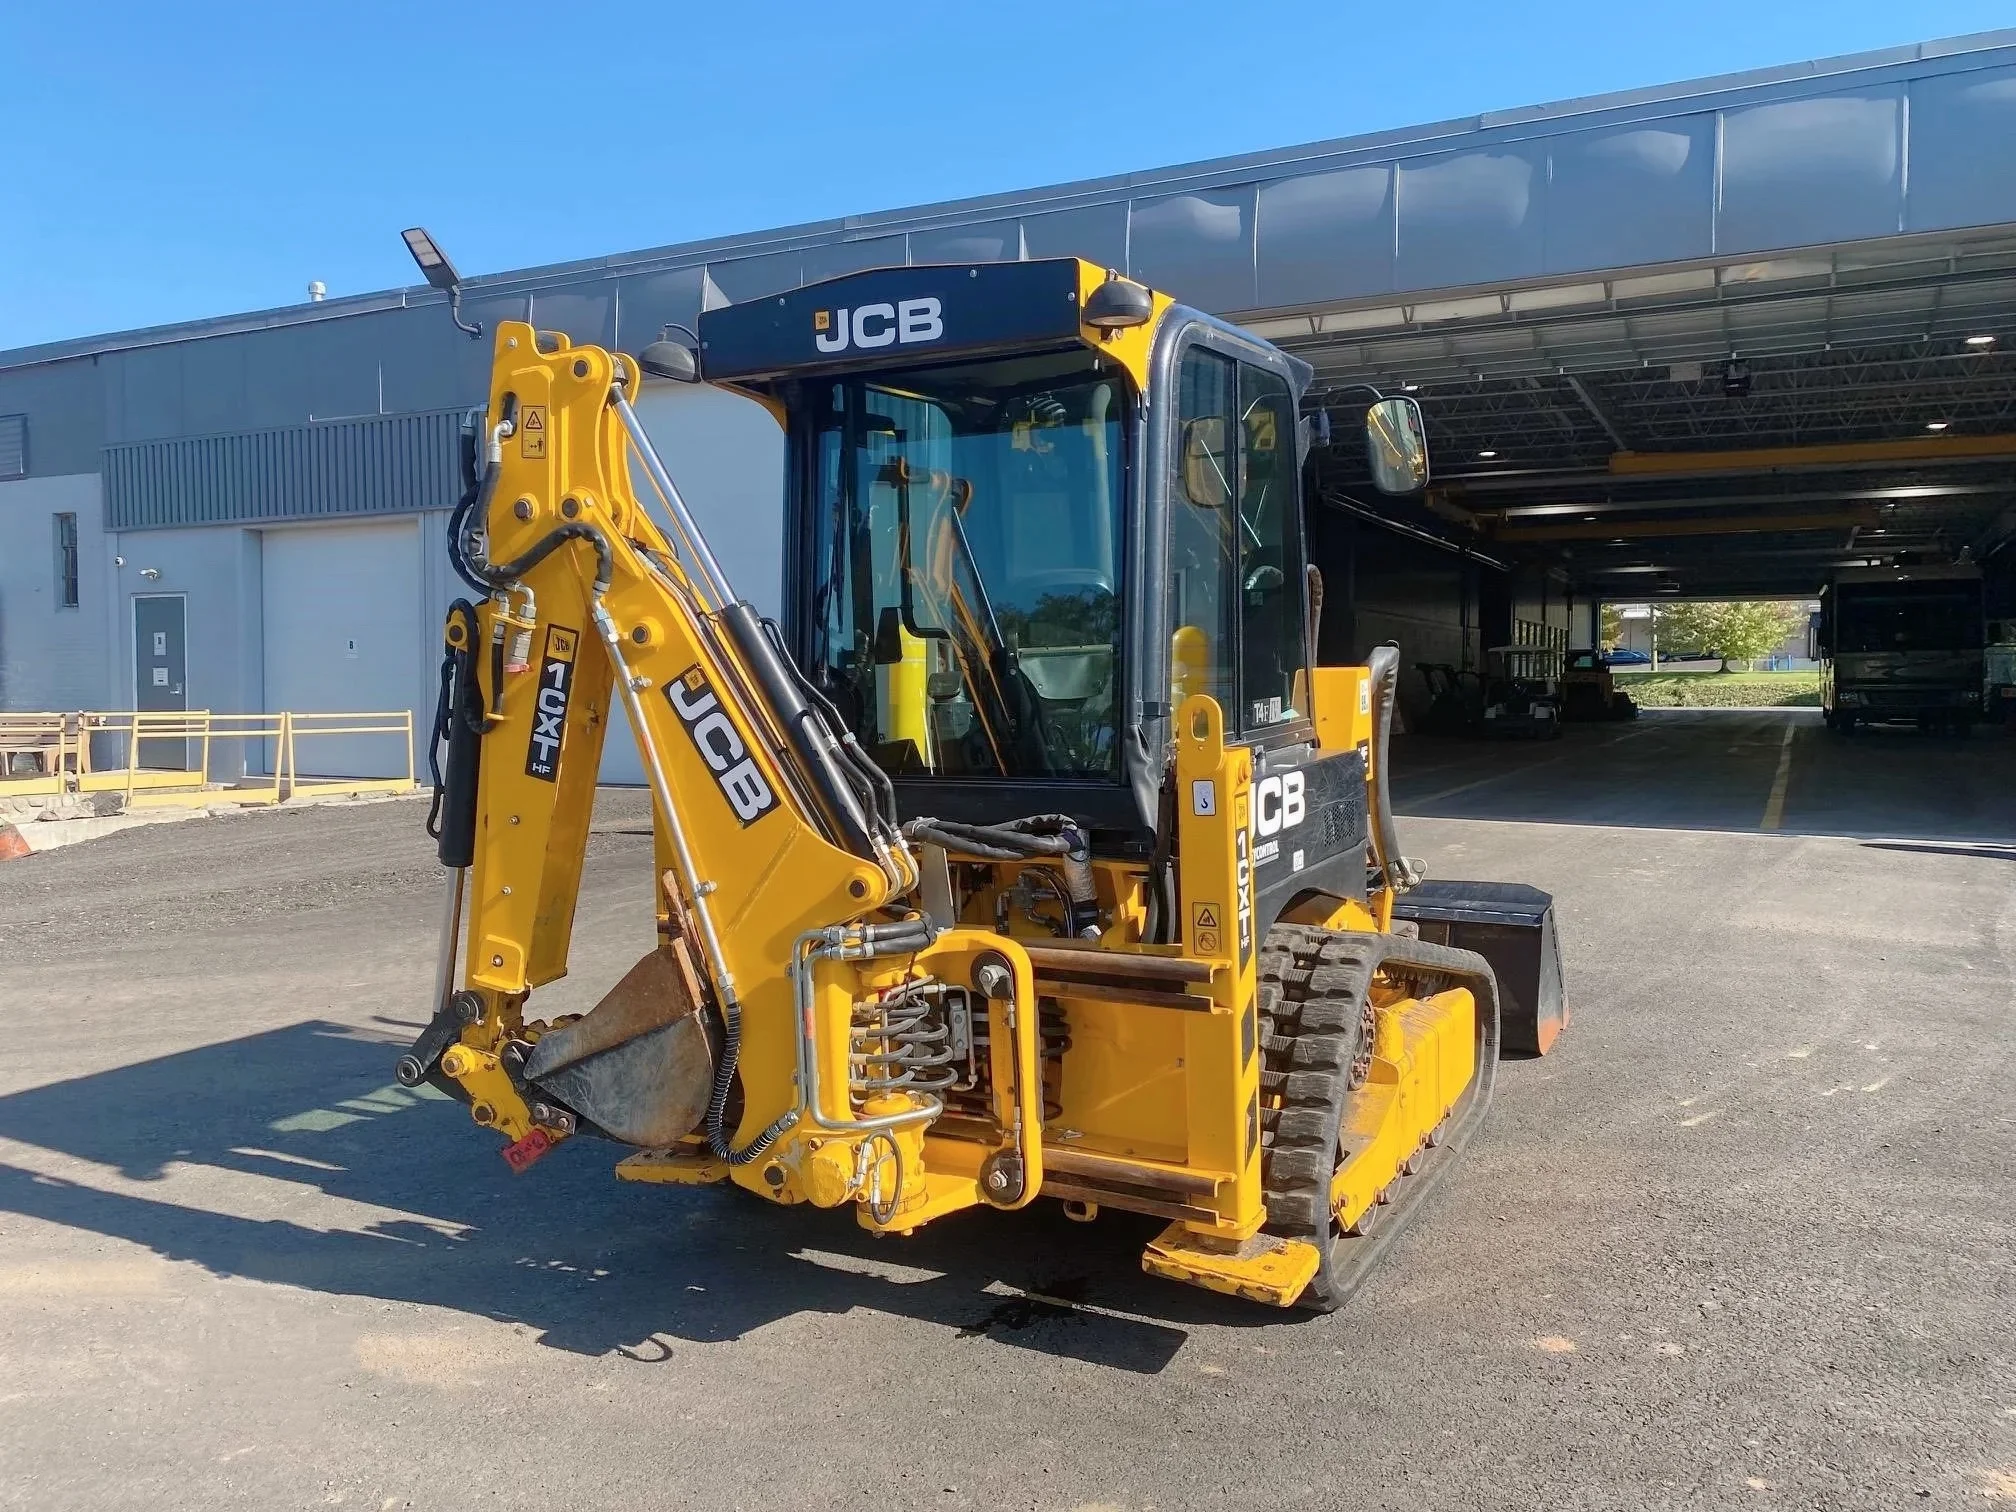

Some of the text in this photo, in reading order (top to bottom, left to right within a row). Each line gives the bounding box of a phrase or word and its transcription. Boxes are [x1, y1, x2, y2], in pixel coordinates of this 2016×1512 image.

[815, 297, 943, 353] JCB
[533, 662, 566, 762] 1CXT
[669, 679, 772, 820] JCB
[531, 762, 551, 774] HF
[1237, 830, 1250, 936] 1CXT
